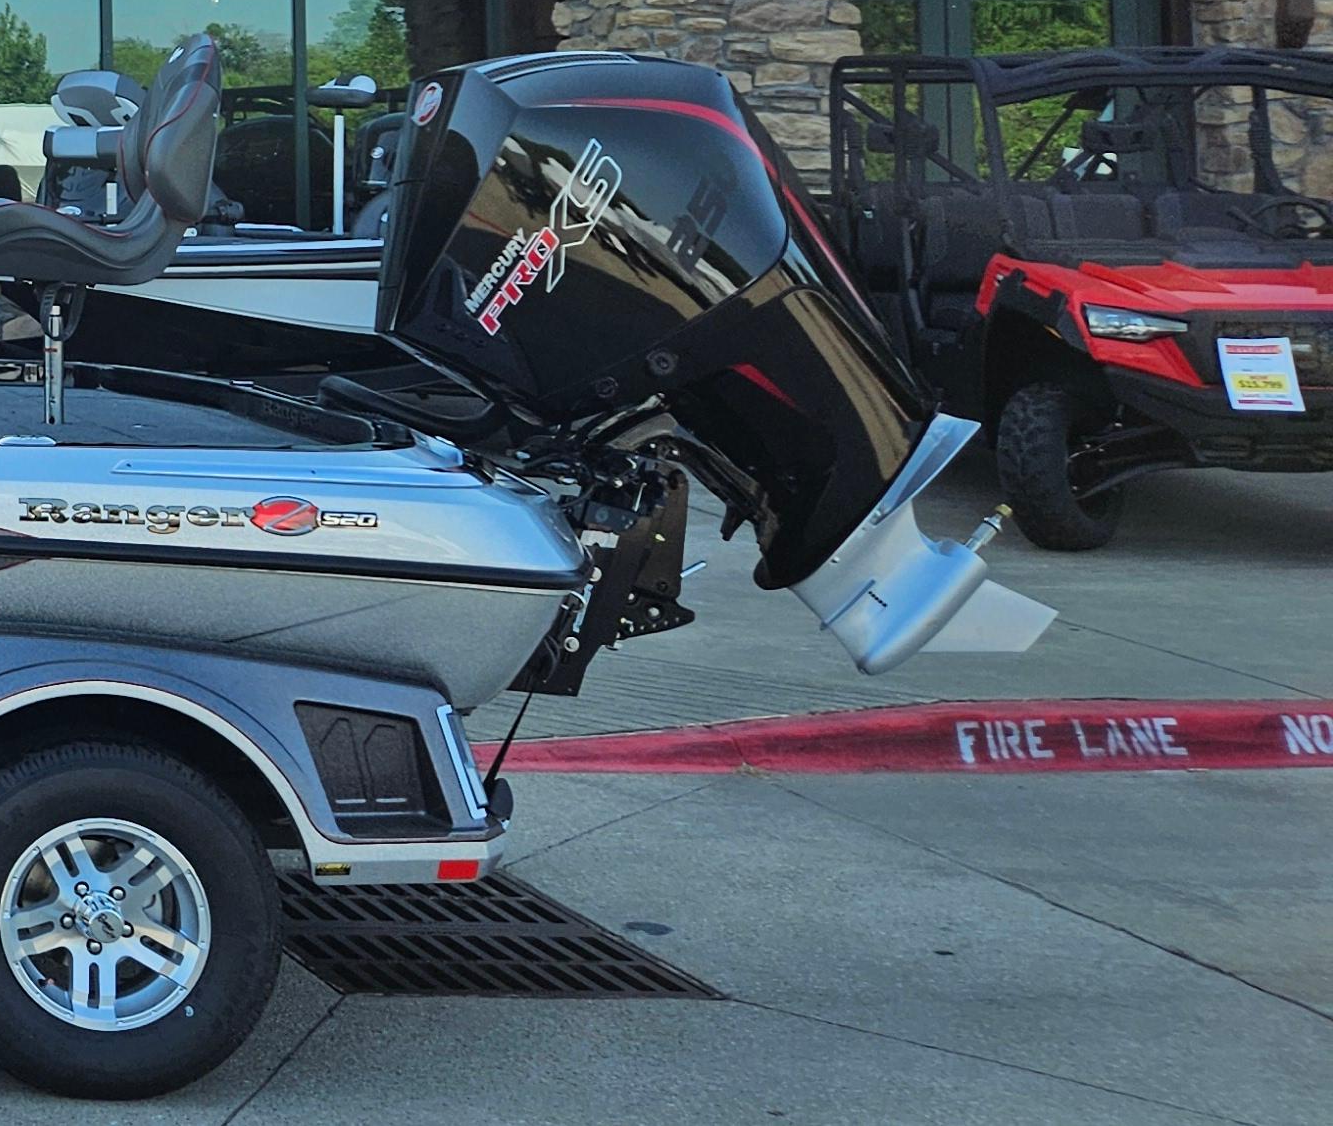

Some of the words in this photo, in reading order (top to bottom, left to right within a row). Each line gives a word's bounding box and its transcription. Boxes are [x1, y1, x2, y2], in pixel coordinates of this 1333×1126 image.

[462, 227, 527, 314] MERCURY
[477, 226, 560, 336] PRO
[547, 137, 623, 293] XS
[18, 497, 254, 535] Ranger
[322, 512, 376, 527] 520
[955, 719, 1055, 764] FIRE
[1072, 717, 1189, 758] LANE
[1280, 714, 1333, 756] NO
